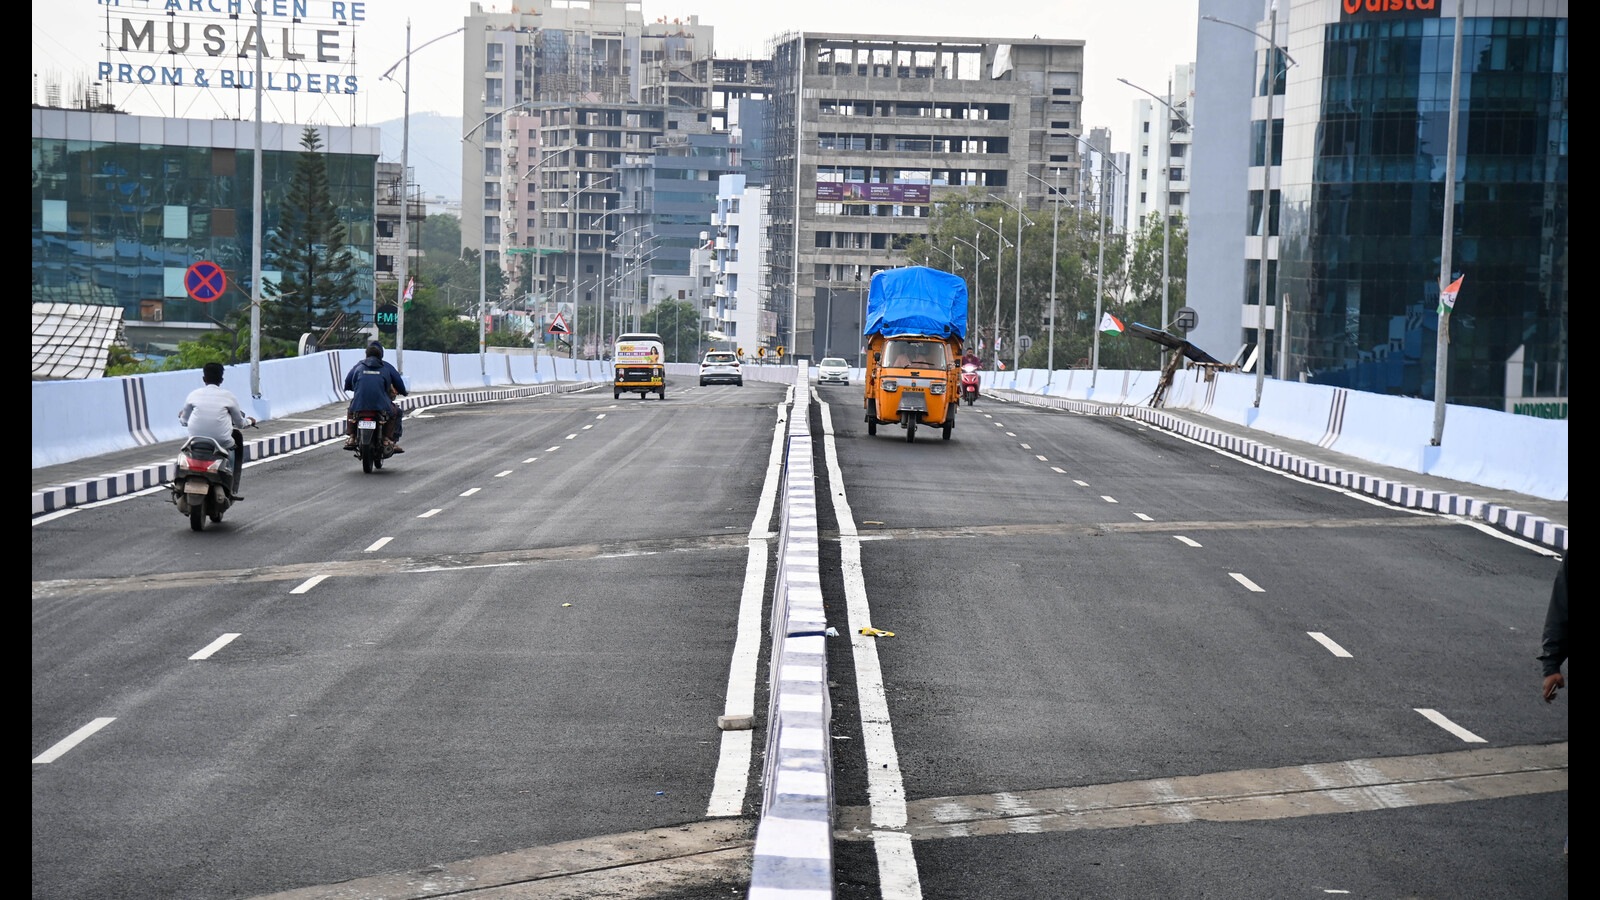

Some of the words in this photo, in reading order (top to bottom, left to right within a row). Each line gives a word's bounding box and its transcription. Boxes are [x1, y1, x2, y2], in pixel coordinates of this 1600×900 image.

[121, 18, 340, 62] MUSALE
[98, 62, 183, 86] PROM
[194, 68, 210, 87] &
[220, 69, 358, 95] BULDERS
